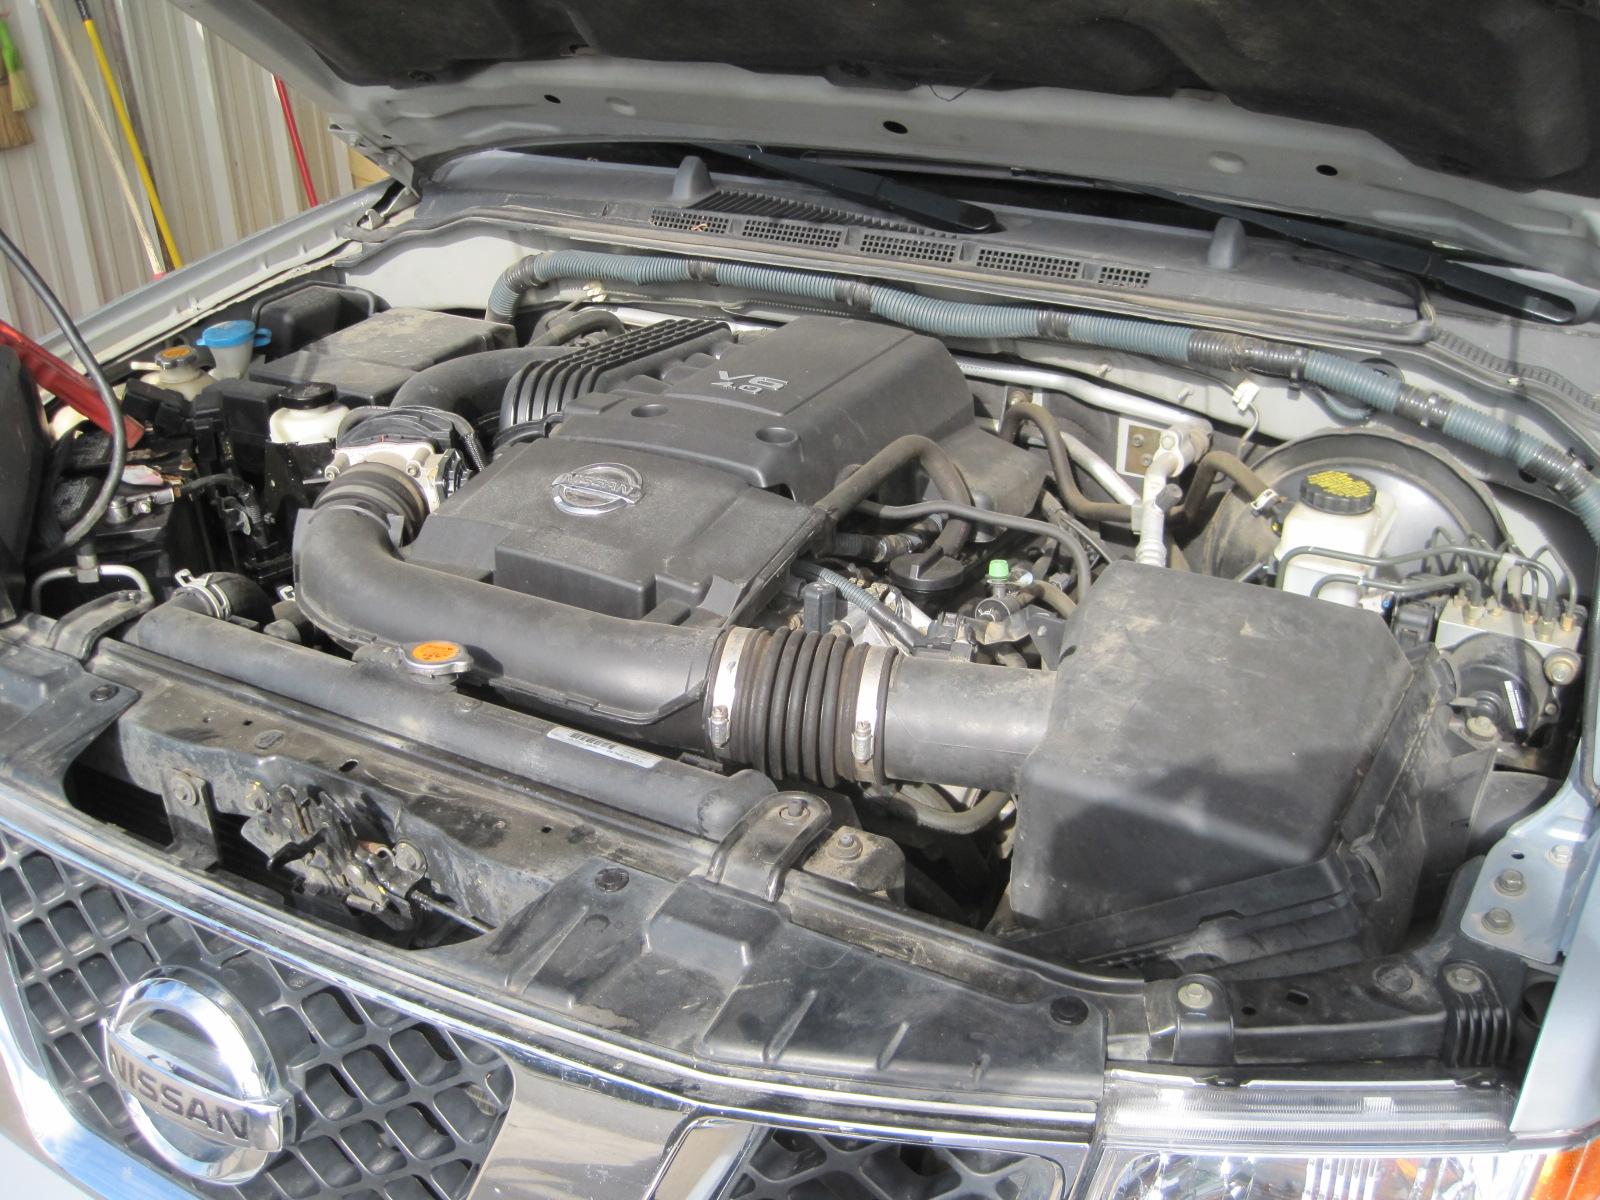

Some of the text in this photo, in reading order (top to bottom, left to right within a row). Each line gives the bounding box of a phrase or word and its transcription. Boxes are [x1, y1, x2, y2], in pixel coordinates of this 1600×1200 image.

[718, 370, 788, 391] V6
[565, 472, 628, 496] NISSAN
[110, 1043, 249, 1140] NISSAN
